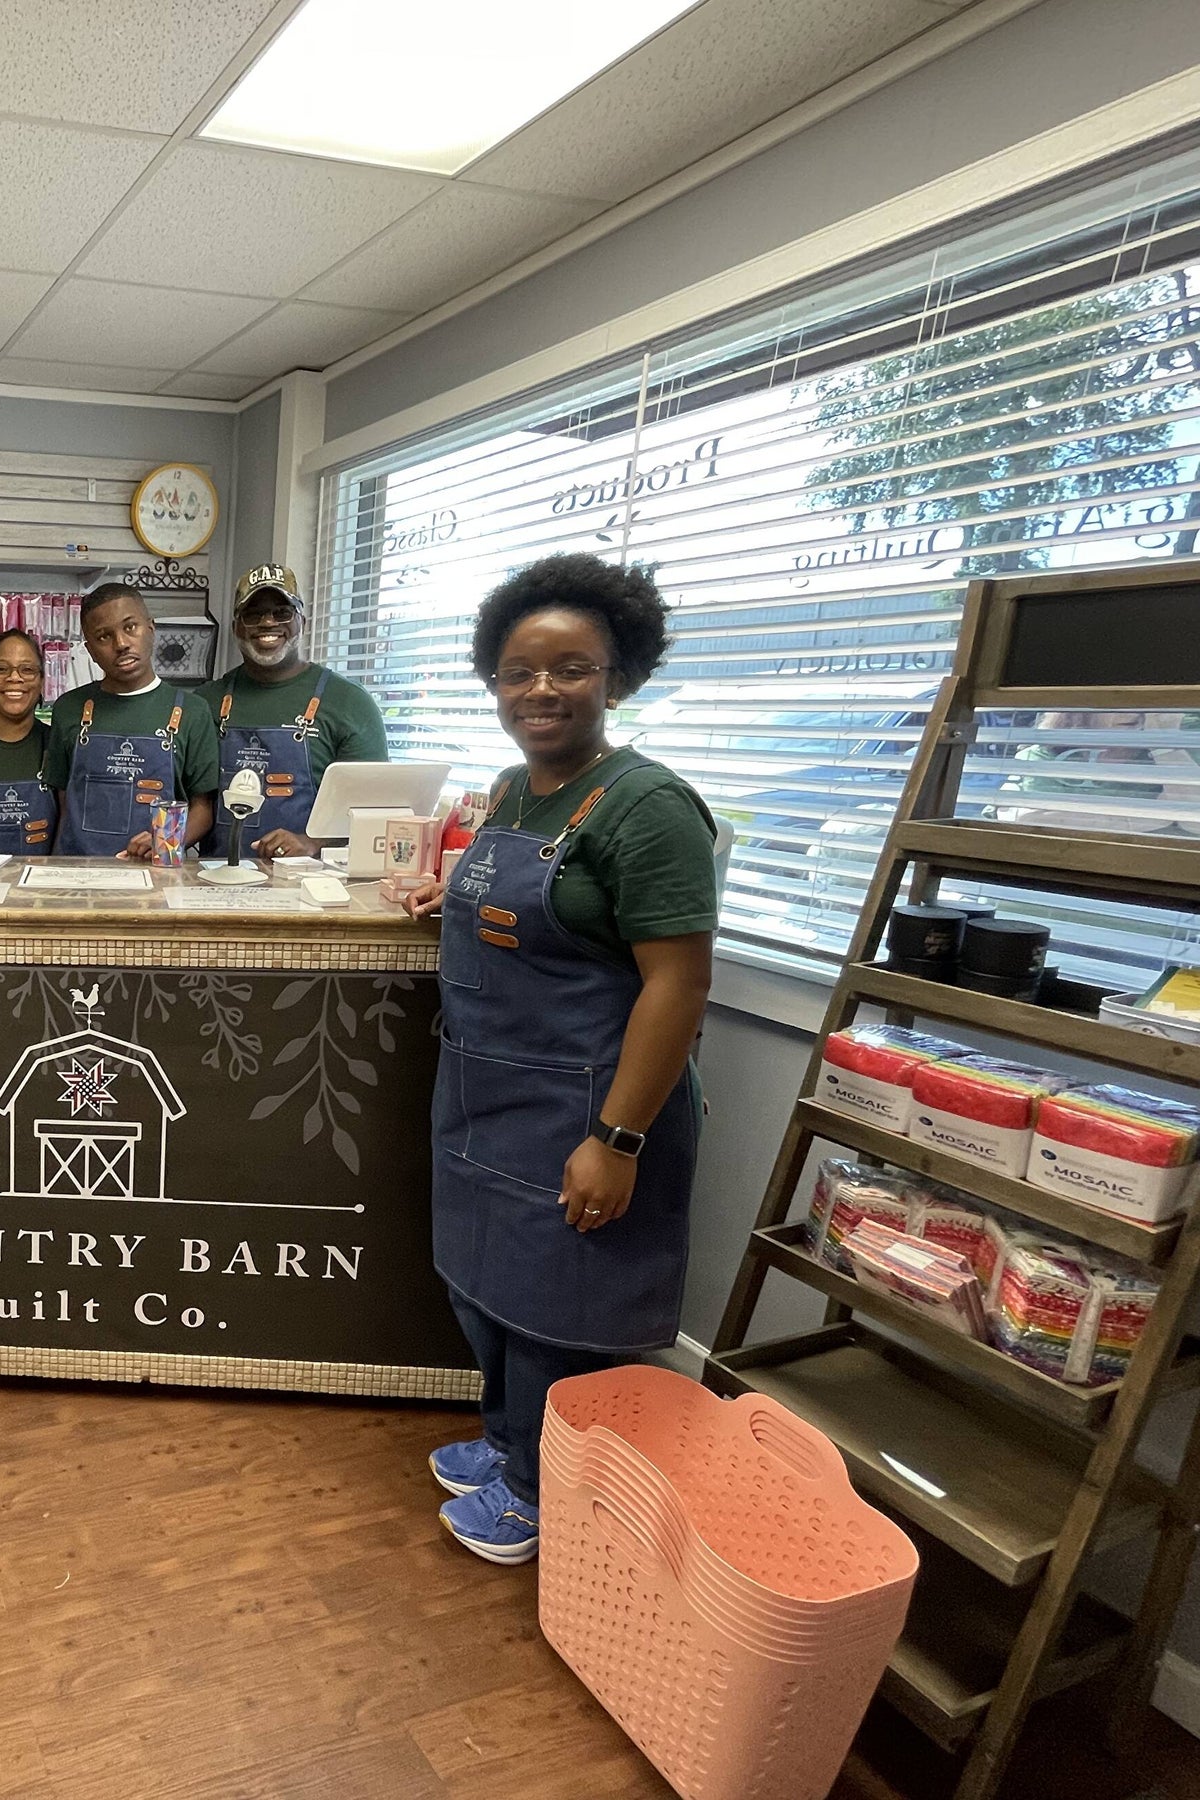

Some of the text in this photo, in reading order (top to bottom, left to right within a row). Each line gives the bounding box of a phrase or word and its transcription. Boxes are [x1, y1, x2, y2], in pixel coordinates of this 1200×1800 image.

[174, 470, 182, 480] 12
[204, 508, 210, 518] 3
[169, 543, 175, 552] 6
[835, 1088, 893, 1113] MOSAIC
[931, 1130, 997, 1157] MOSAIC
[1053, 1165, 1134, 1196] MOSAIC
[178, 1238, 364, 1281] BARN
[134, 1292, 227, 1330] Co.
